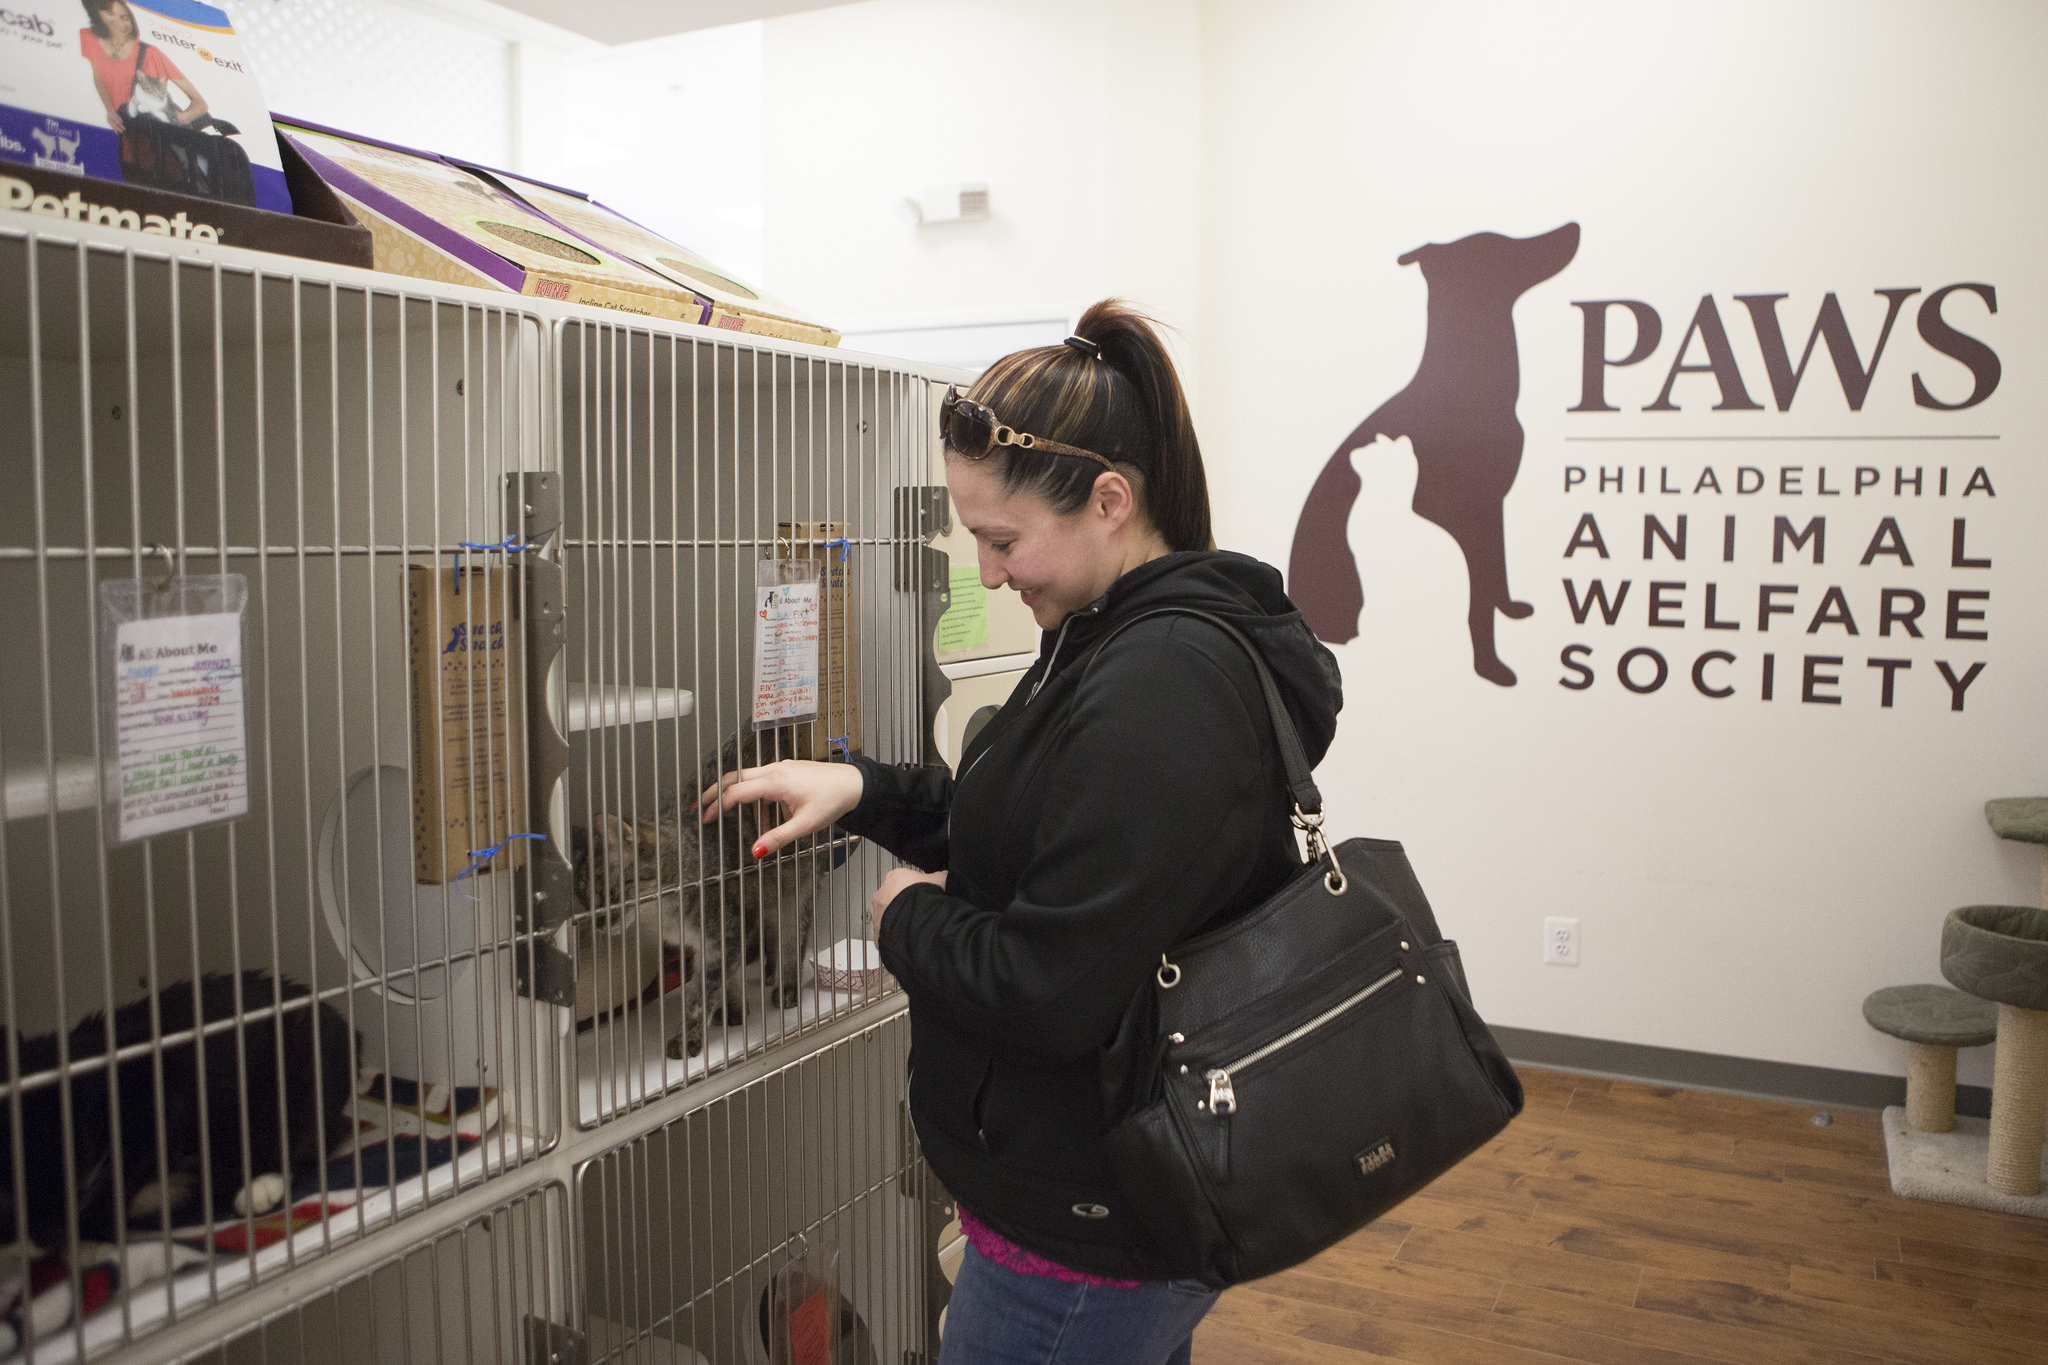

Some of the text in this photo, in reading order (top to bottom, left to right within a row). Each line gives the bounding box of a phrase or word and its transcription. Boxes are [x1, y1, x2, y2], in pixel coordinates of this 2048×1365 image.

[151, 30, 197, 51] enter
[214, 56, 245, 73] exit
[535, 278, 570, 301] KONG
[718, 315, 745, 331] KONG
[1566, 281, 2002, 413] PAWS
[1563, 466, 1997, 497] PHILADELPHIA
[1563, 513, 1993, 569] ANIMAL
[1561, 578, 1991, 641] WELFARE
[157, 644, 195, 659] About
[197, 642, 217, 655] Me
[1558, 644, 1987, 712] SOCIETY
